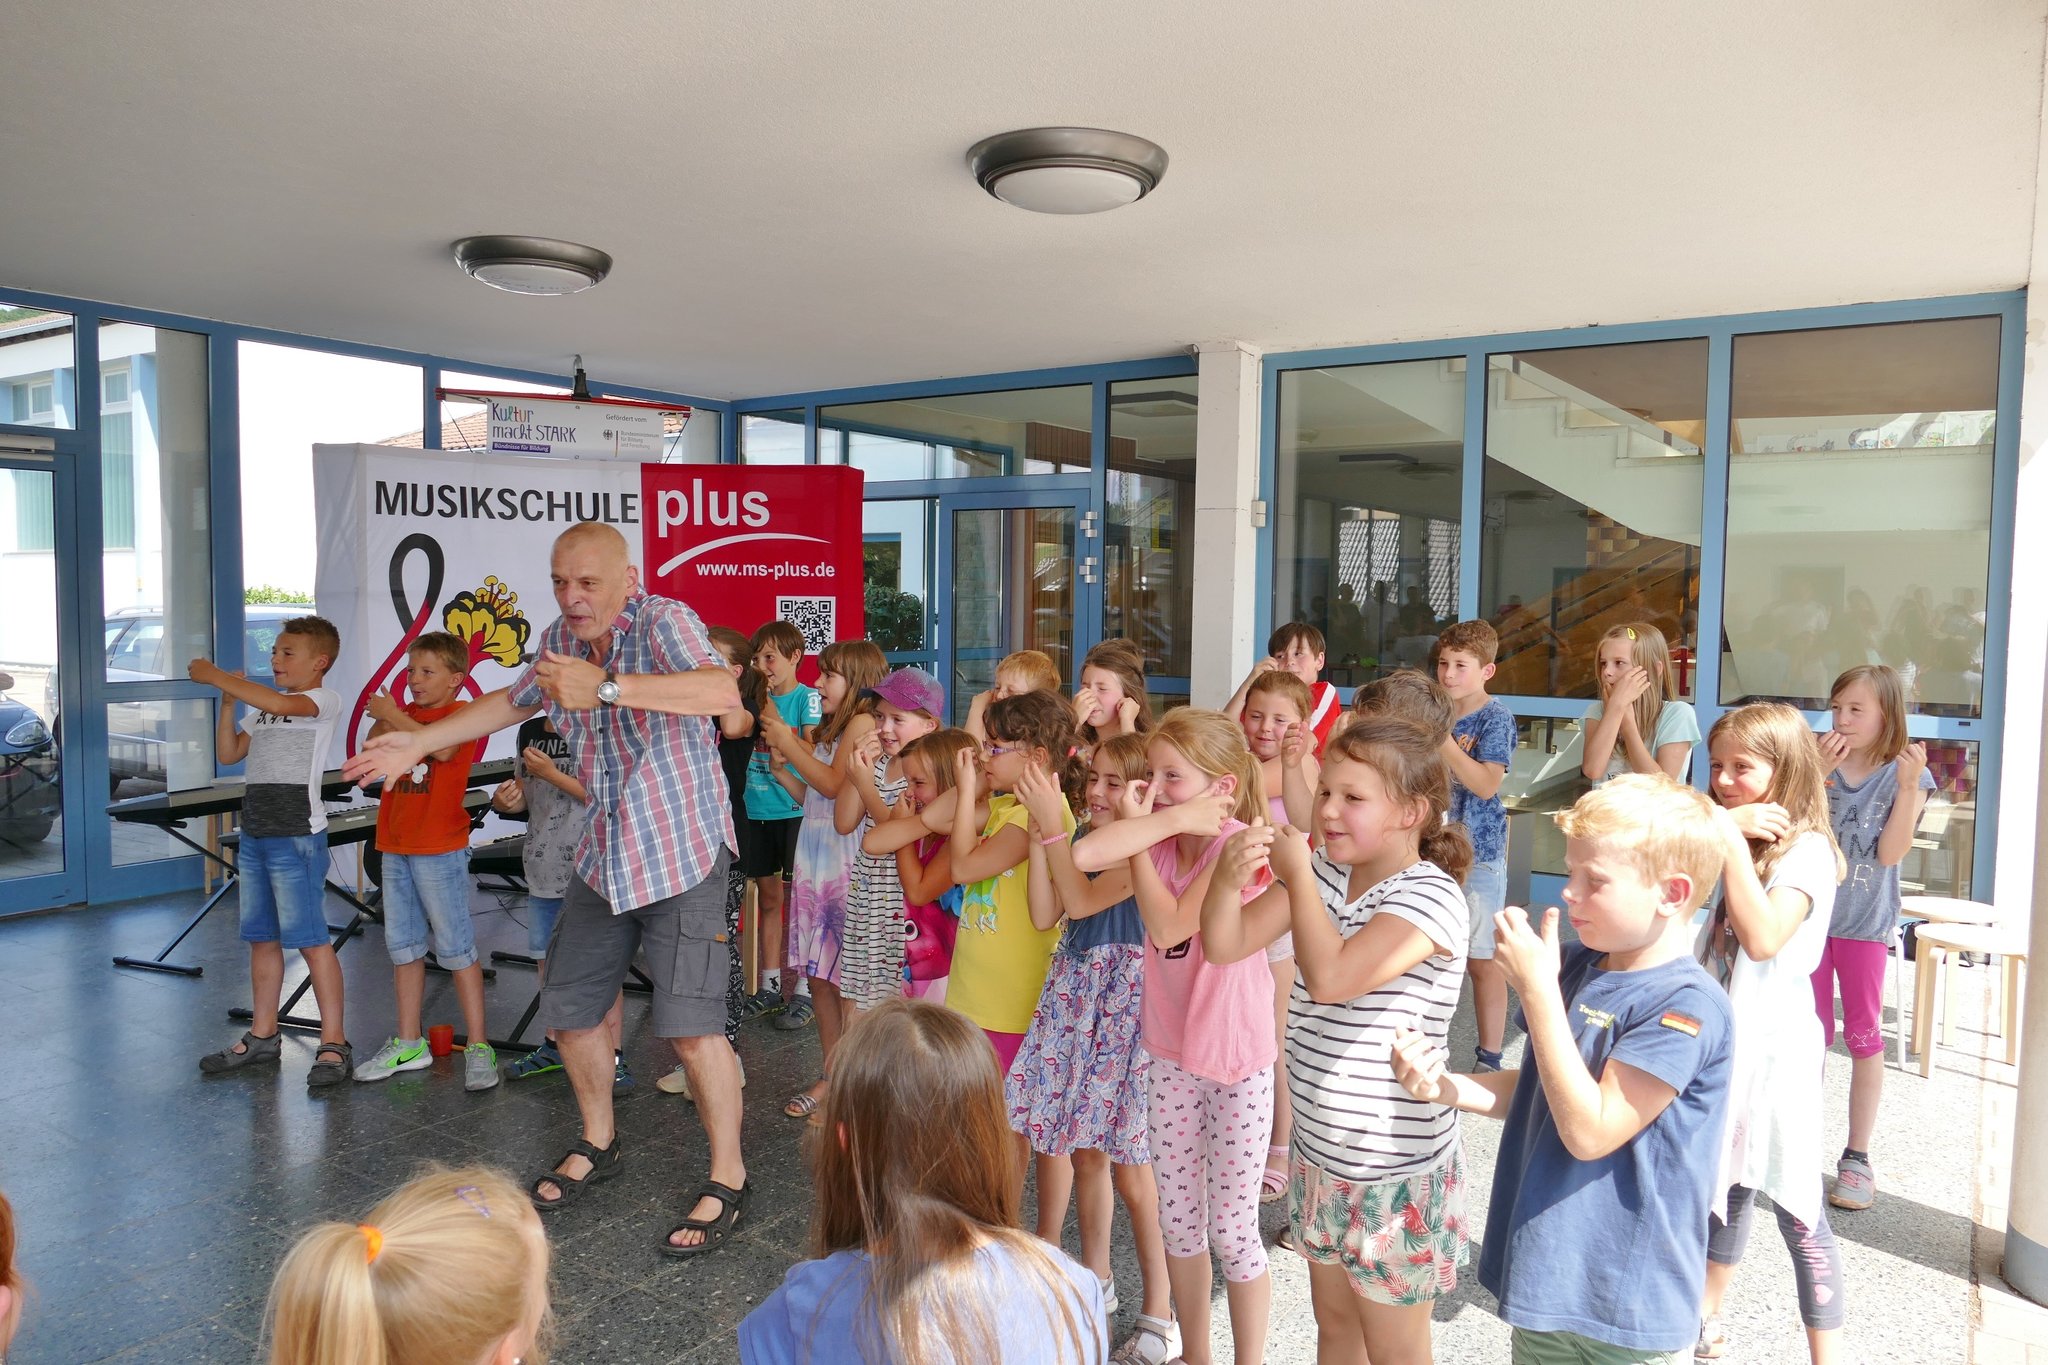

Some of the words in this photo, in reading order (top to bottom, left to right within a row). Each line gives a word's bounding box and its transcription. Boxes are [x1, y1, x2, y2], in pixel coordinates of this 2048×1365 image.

[492, 403, 534, 422] Kultur
[606, 414, 634, 422] Gefördert
[492, 424, 532, 440] macht
[536, 425, 577, 443] STARK
[494, 442, 520, 450] Bündnisse
[529, 444, 549, 453] Bildung
[375, 480, 639, 523] MUSIKSCHULE
[657, 478, 770, 538] plus
[696, 561, 836, 580] www.ms-plus.de
